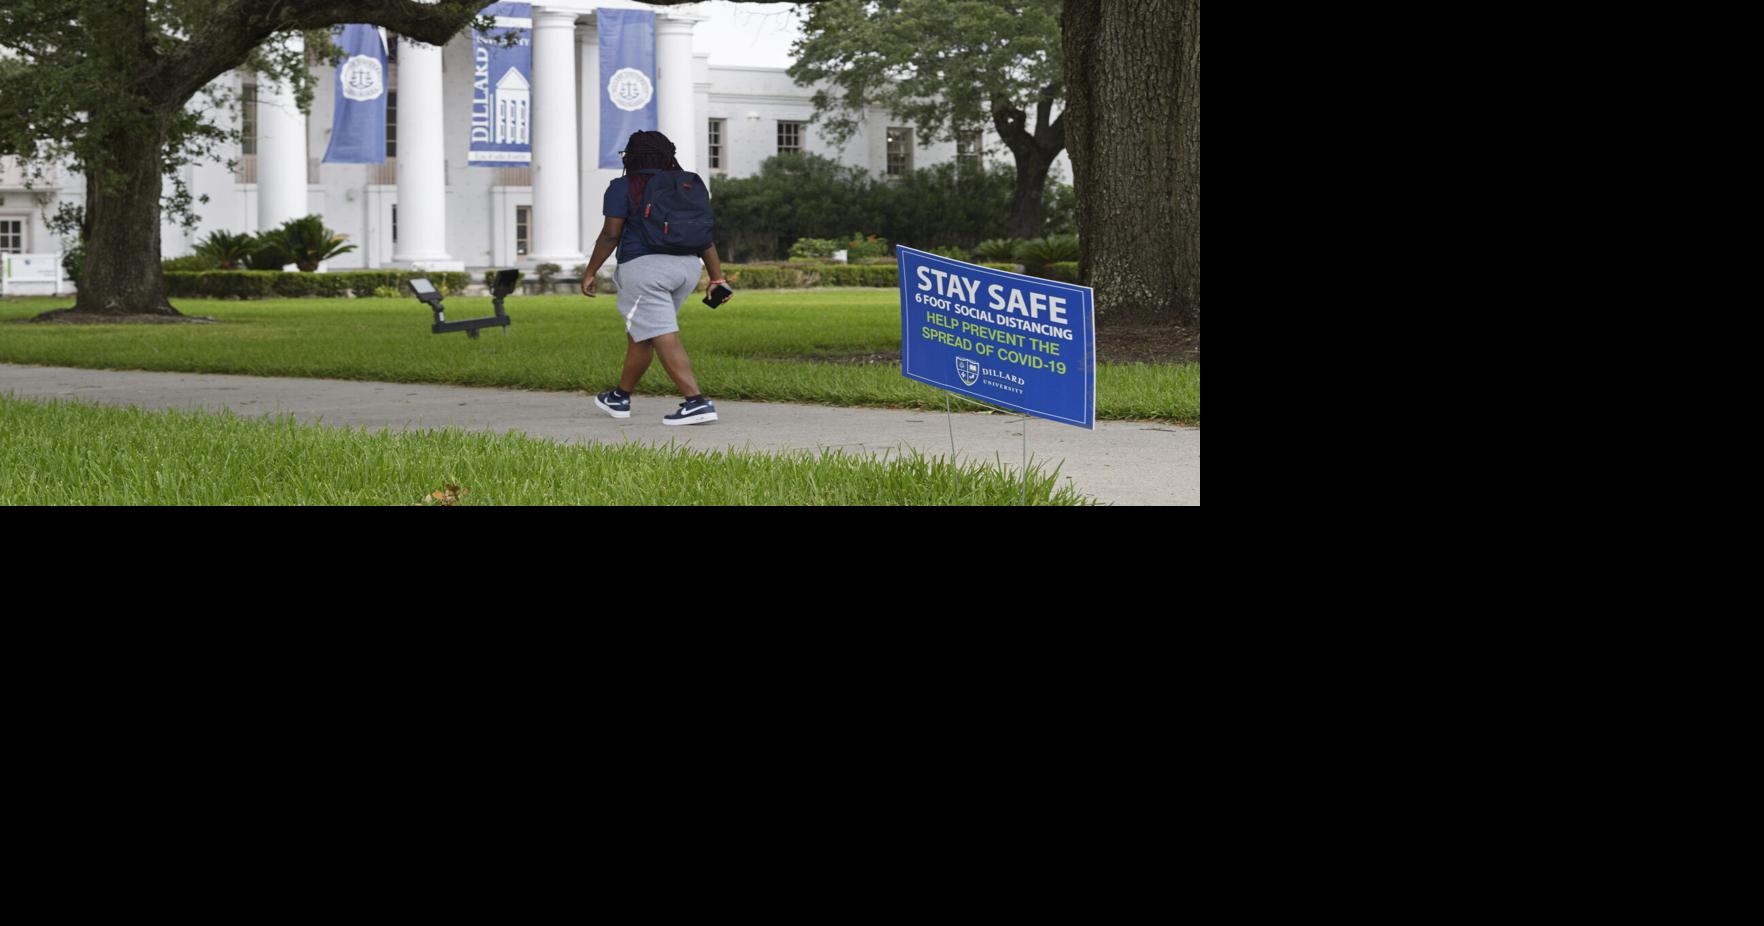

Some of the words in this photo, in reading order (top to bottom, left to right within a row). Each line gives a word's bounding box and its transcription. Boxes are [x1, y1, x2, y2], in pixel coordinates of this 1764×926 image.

[471, 47, 489, 142] DILLARD
[915, 293, 922, 303] 6
[923, 294, 952, 311] FOOT
[954, 303, 995, 323] SOCIAL
[996, 314, 1073, 340] DISTANCING
[916, 265, 981, 304] STAY
[988, 284, 1068, 325] SAFE
[922, 326, 972, 351] SPREAD
[975, 342, 994, 357] OF
[997, 347, 1067, 375] COVID-19
[927, 311, 959, 330] HELP
[962, 321, 1026, 348] PREVENT
[1029, 337, 1060, 356] THE
[982, 368, 1025, 385] DILLARD
[983, 379, 1024, 394] UNIVERSITY
